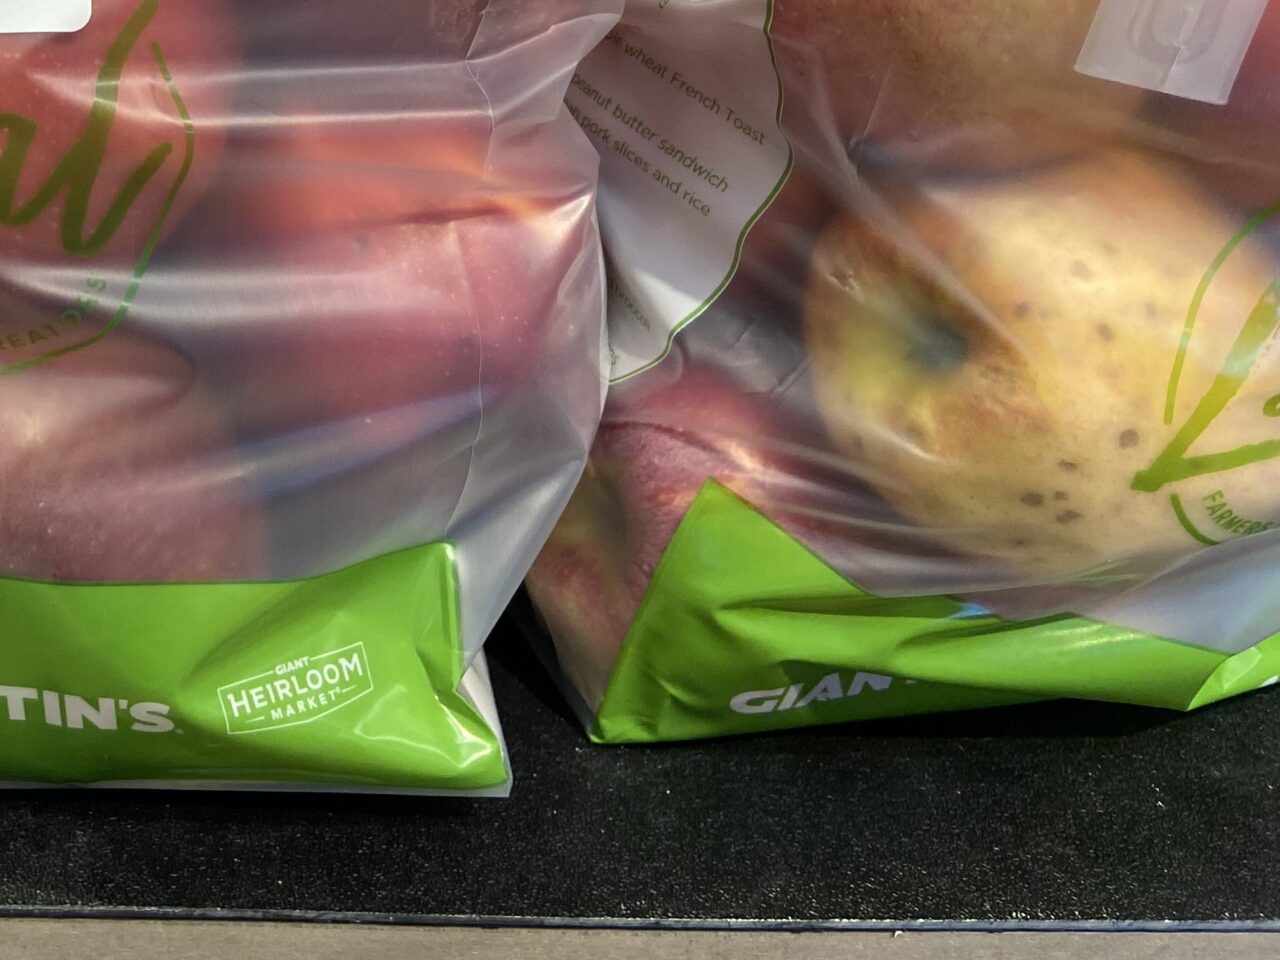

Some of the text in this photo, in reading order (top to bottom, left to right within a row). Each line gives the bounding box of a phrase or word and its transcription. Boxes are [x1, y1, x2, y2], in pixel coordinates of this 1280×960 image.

[624, 43, 668, 78] wheat
[670, 72, 721, 114] French
[724, 107, 766, 146] Toast
[571, 73, 729, 193] peanut butter sandwich
[579, 116, 611, 144] pork
[613, 139, 650, 173] slices
[652, 168, 683, 194] and
[682, 190, 711, 217] rice
[227, 652, 363, 718] HEIRLOOM
[275, 656, 310, 675] GIANT
[729, 671, 918, 714] GIAN
[271, 688, 339, 721] MARKET
